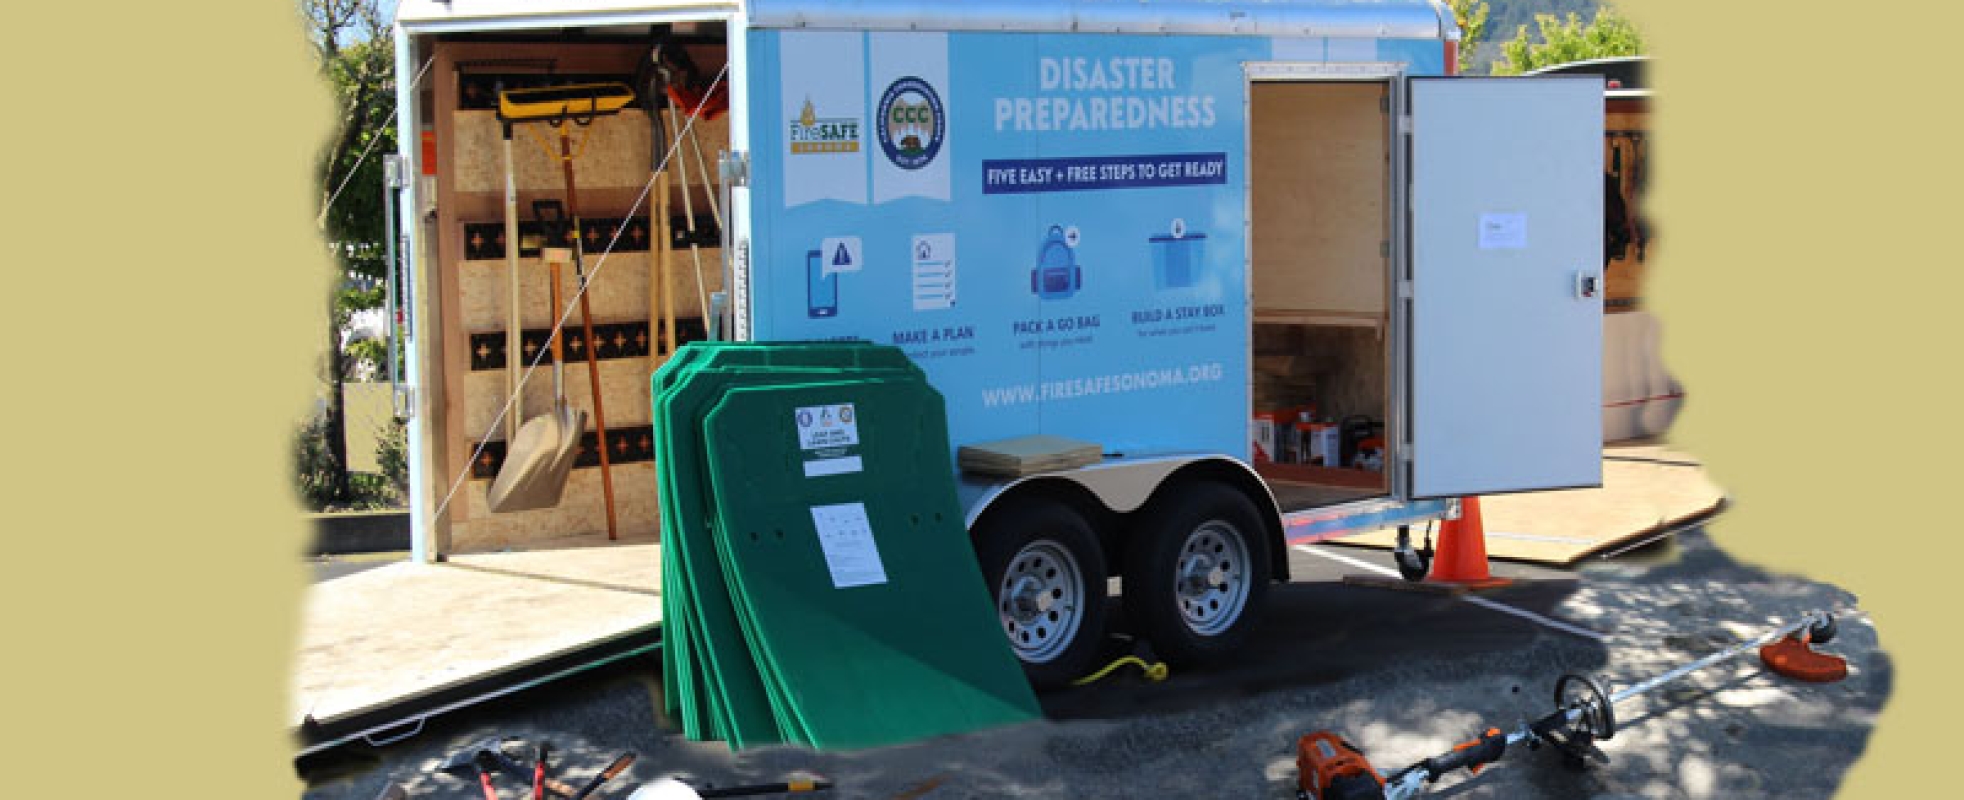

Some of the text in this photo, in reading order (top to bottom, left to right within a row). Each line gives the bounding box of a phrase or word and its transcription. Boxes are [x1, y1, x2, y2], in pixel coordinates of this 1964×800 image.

[1040, 57, 1175, 91] DISASTER
[893, 107, 929, 124] CCC
[994, 95, 1216, 131] PREPAREDNESS
[987, 168, 1017, 185] FIVE
[1021, 167, 1052, 184] EASY
[1067, 165, 1096, 182] FREE
[1100, 164, 1135, 180] STEPS
[1138, 163, 1155, 179] TO
[1158, 162, 1181, 178] GET
[1184, 160, 1223, 177] READY
[1013, 320, 1043, 336] PACK
[1058, 317, 1074, 331] GO
[1077, 314, 1100, 328] BAG
[1132, 310, 1162, 324] BUILD
[1176, 306, 1200, 319] STAY
[1203, 303, 1225, 317] BOX
[892, 329, 928, 344] MAKE
[943, 326, 974, 341] PLAN
[982, 363, 1222, 407] WWW.FIRESAFESONOMA.ORG
